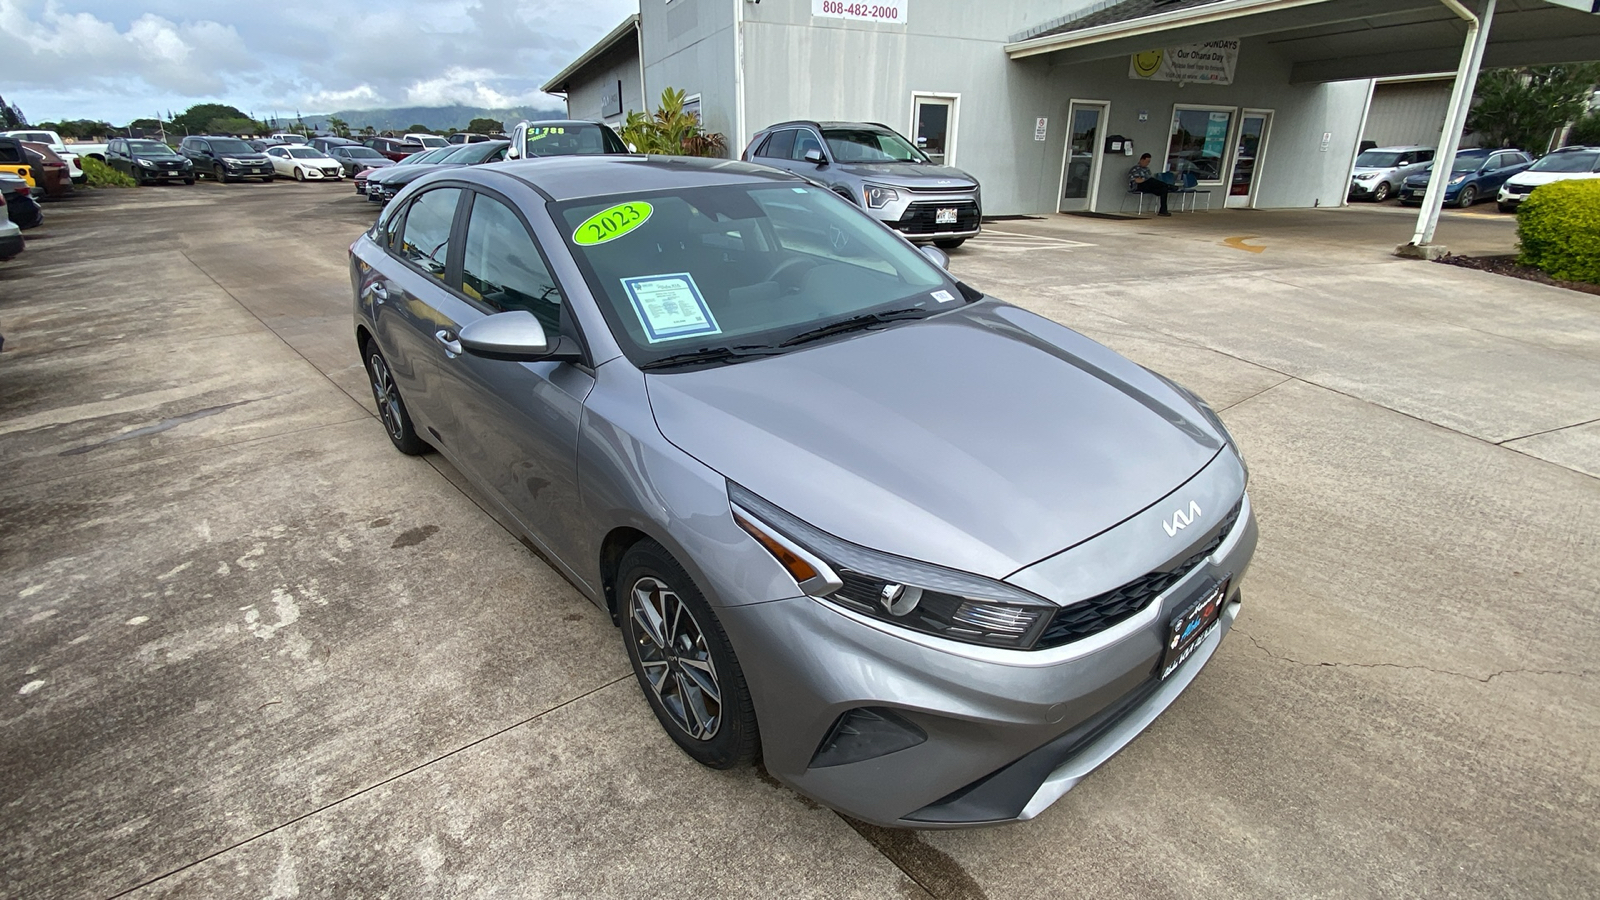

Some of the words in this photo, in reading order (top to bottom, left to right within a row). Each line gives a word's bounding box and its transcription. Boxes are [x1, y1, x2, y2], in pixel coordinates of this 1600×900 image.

[823, 1, 898, 19] 808-482-2000
[1177, 50, 1190, 59] Our
[1191, 51, 1211, 61] Ohana
[1212, 53, 1224, 63] Day
[588, 205, 640, 240] 2023
[1162, 500, 1201, 537] KIA
